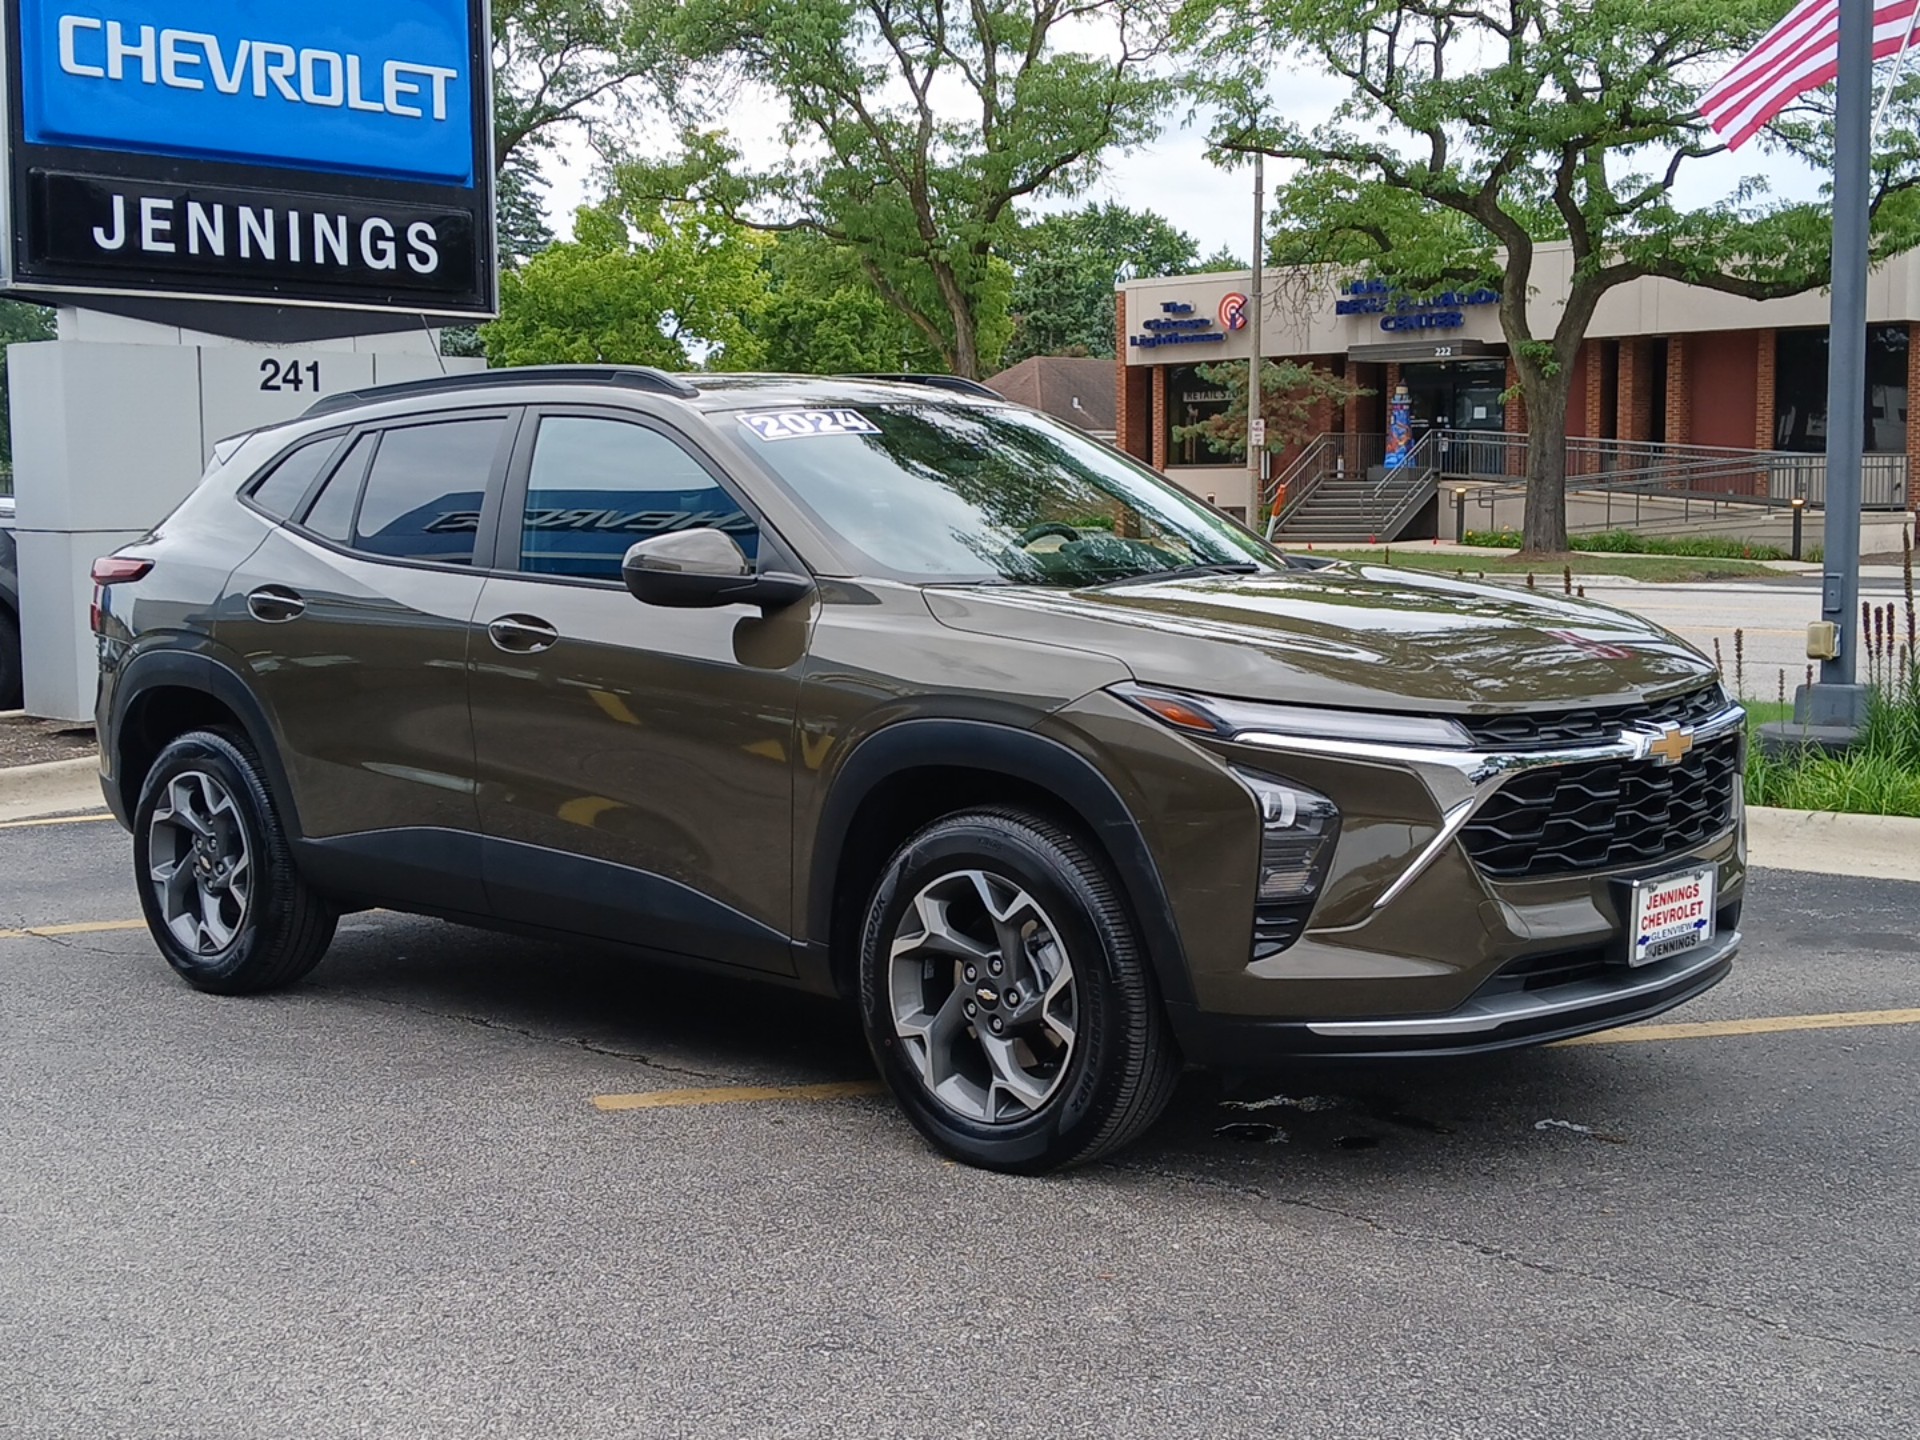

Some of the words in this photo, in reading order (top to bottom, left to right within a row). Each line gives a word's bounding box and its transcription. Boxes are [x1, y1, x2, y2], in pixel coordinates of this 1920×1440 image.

[59, 15, 458, 121] CHEVROLET
[93, 195, 439, 274] JENNINGS
[1380, 311, 1464, 332] CENTER
[1435, 347, 1452, 357] 222
[260, 359, 321, 393] 241
[1186, 390, 1217, 401] RETAIL
[750, 411, 869, 438] 2024
[1646, 883, 1699, 910] JENNINGS
[1641, 900, 1703, 931] CHEVROLET
[1651, 922, 1693, 941] GLENVIEW
[1652, 934, 1697, 957] JENNINGS
